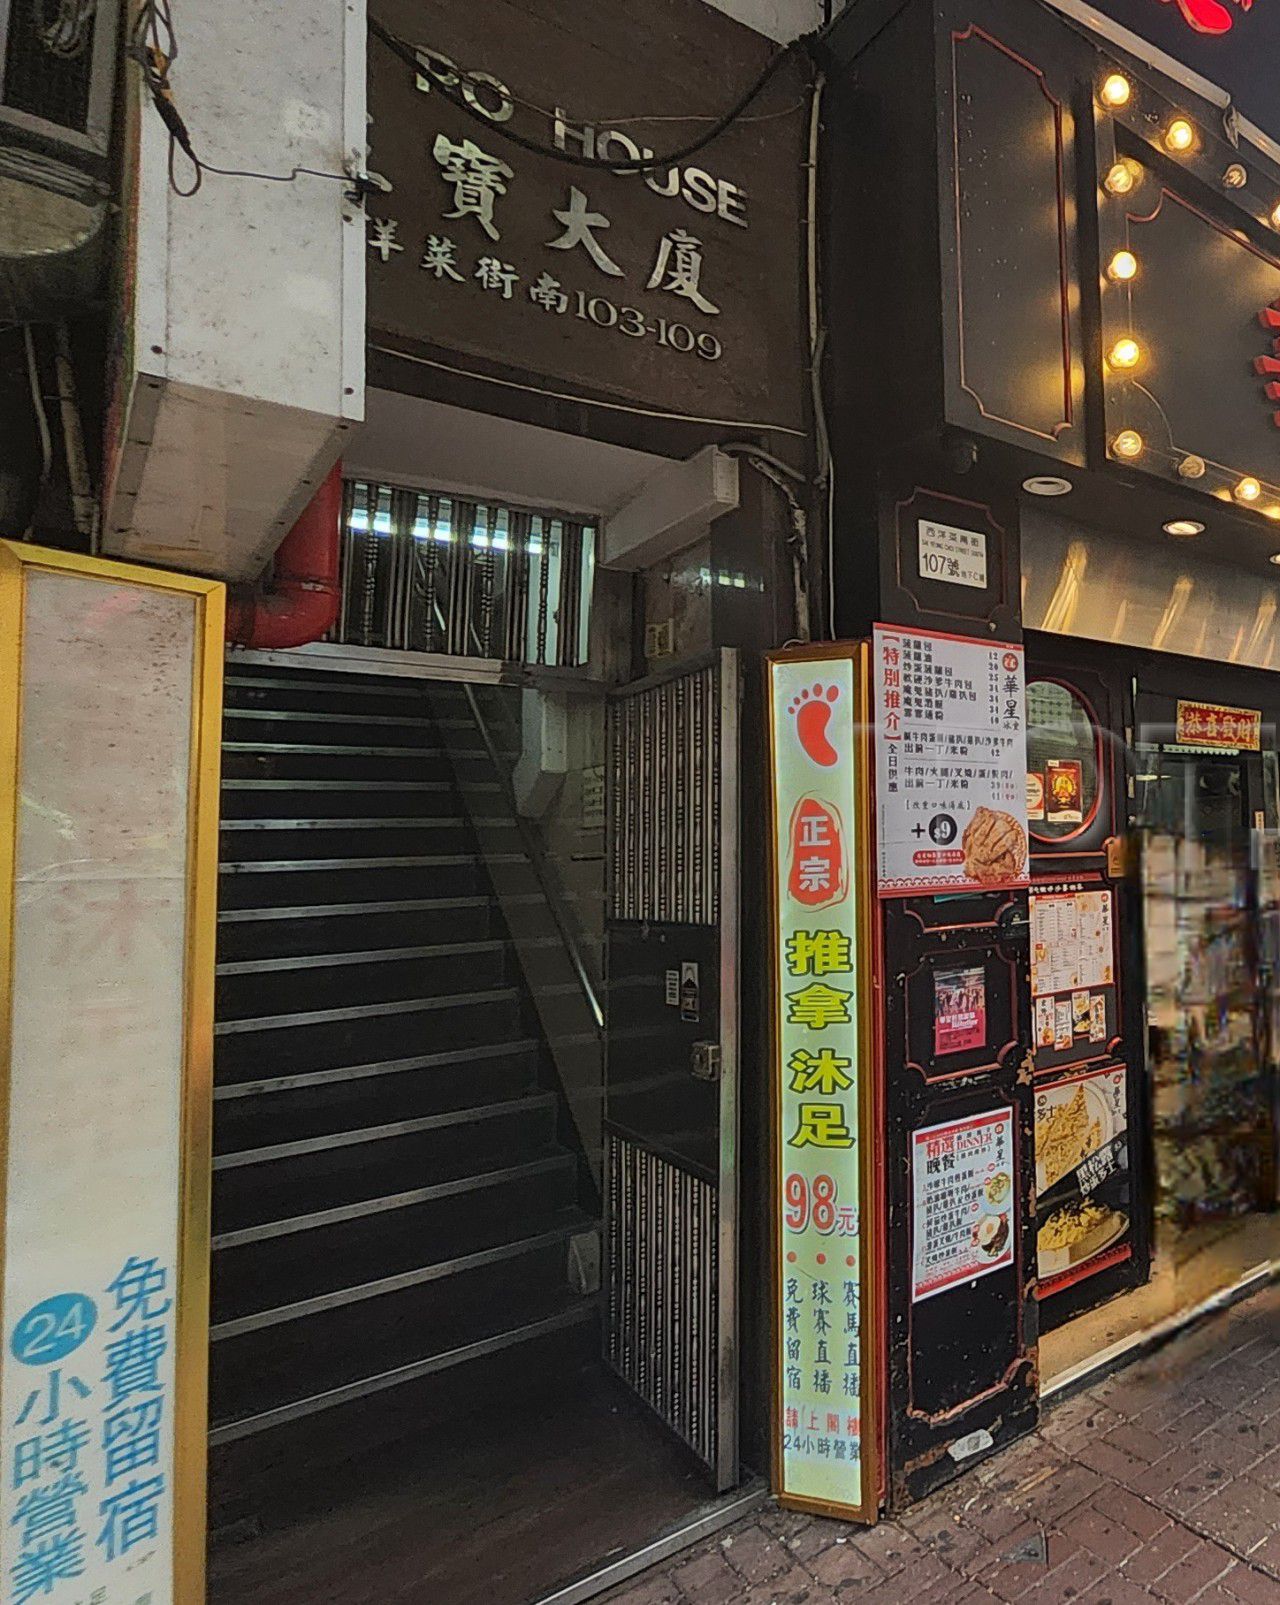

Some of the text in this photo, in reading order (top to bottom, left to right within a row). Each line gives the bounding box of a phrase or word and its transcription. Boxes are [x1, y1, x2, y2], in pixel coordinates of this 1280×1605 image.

[366, 116, 721, 315] 寶大廈
[554, 107, 748, 228] HOUSE
[1003, 675, 1020, 720] 華星
[798, 815, 833, 893] 正宗
[786, 929, 855, 1149] 推拿沐足
[786, 1278, 804, 1391] 免費留宿
[812, 1280, 833, 1396] 球賽直播
[842, 1280, 860, 1399] 賽馬直播
[95, 1256, 172, 1562] 免費留宿
